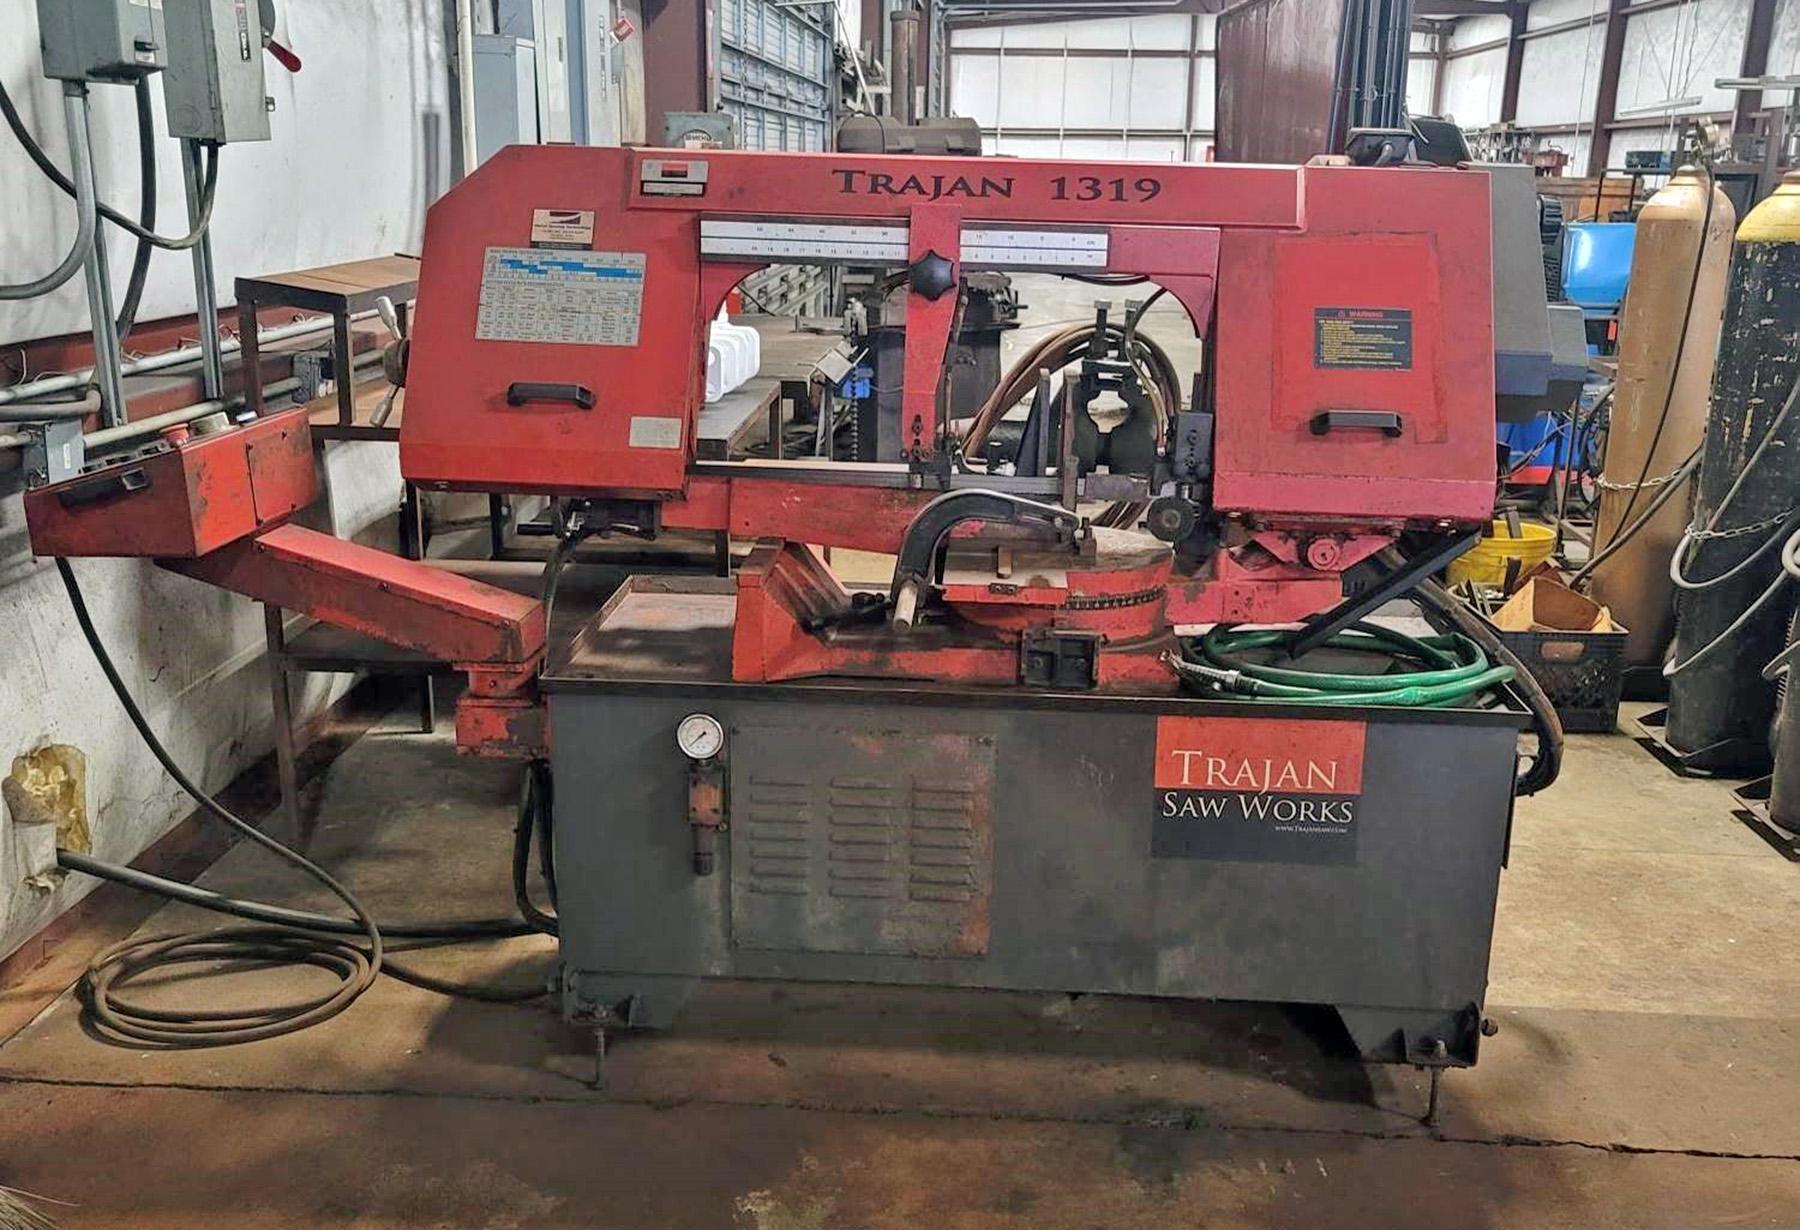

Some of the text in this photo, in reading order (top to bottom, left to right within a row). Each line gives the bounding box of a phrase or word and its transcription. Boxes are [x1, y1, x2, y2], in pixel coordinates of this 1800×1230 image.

[832, 169, 1162, 202] TRAJAN 1319
[1171, 750, 1338, 795] TRAJAN
[1162, 791, 1354, 823] SAW WORKS
